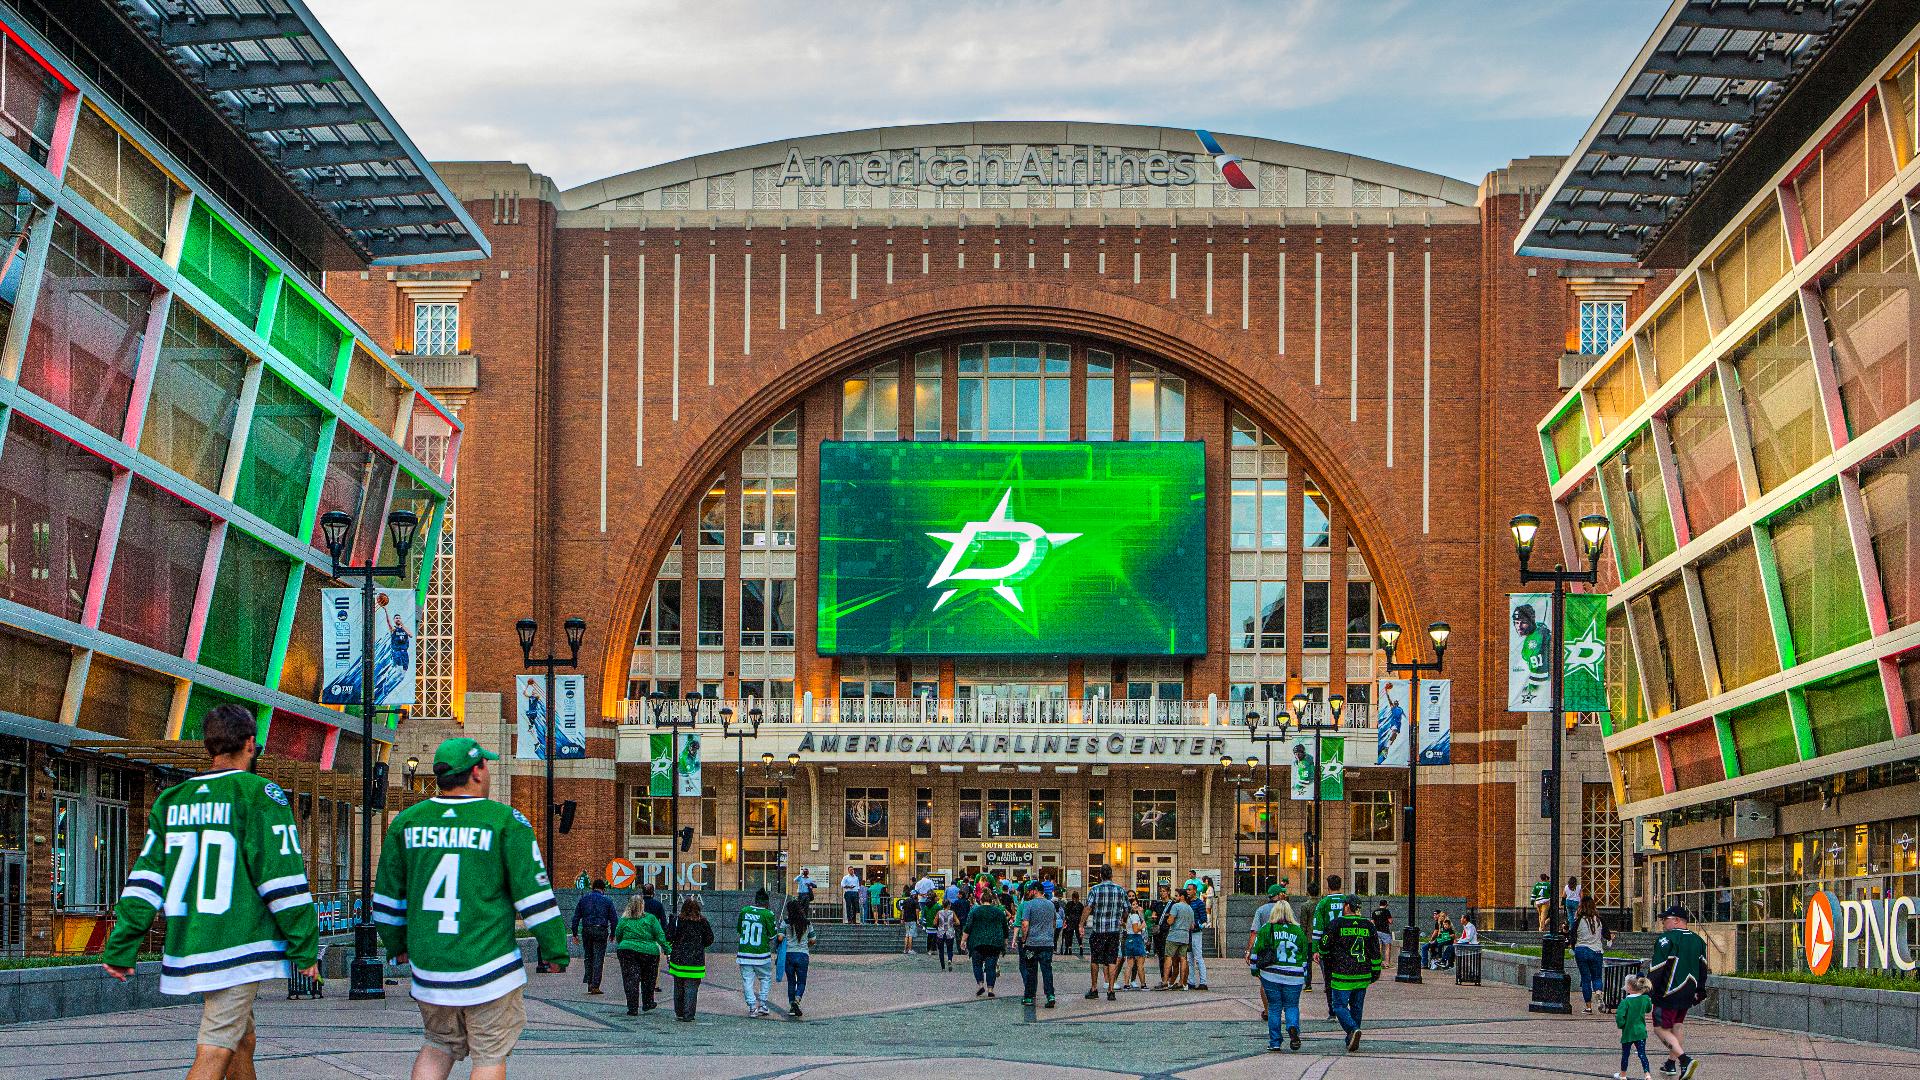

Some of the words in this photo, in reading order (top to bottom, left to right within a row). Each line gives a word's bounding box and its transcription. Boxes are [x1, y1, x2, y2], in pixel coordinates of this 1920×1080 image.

[1530, 654, 1543, 669] 91
[1107, 732, 1226, 755] CENTER
[166, 802, 231, 826] DAMIANI
[403, 826, 494, 851] HEISKANEN
[163, 829, 238, 916] 70
[643, 862, 708, 887] PNC
[421, 853, 461, 935] 4
[660, 893, 705, 906] PLAA
[740, 920, 764, 946] 30
[1840, 895, 1916, 971] PNC
[1350, 936, 1366, 963] 4
